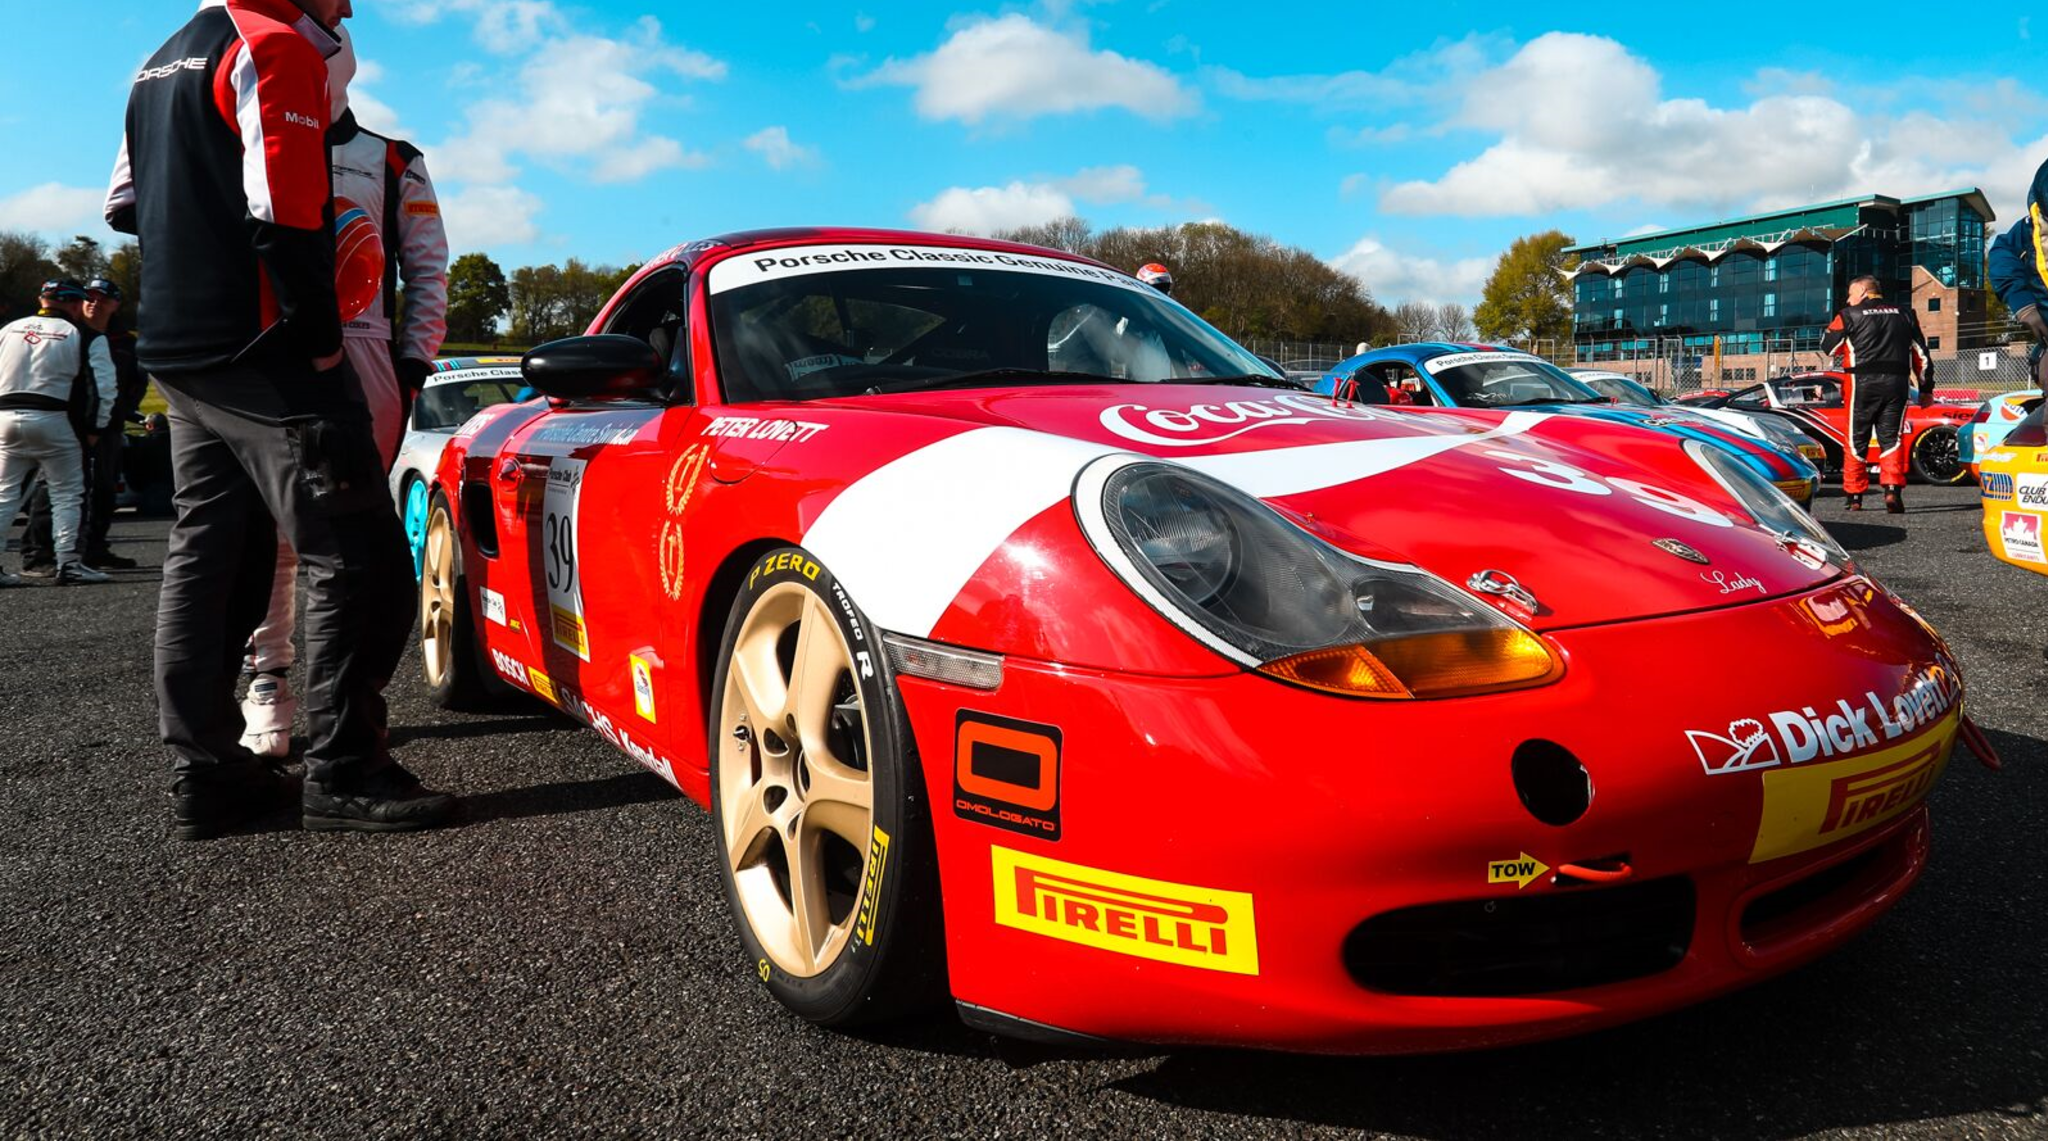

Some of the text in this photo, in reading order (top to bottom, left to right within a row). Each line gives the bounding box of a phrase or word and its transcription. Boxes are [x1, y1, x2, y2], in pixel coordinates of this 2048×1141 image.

[135, 58, 208, 83] ORSCHE
[285, 111, 319, 129] Mobil
[754, 249, 886, 272] Porsche
[888, 249, 991, 266] Classic
[993, 255, 1100, 279] Genuine
[433, 370, 488, 383] Porsche
[700, 416, 830, 443] PETER LOVETT
[1484, 450, 1734, 528] 39
[2019, 485, 2046, 496] CLUB
[2022, 495, 2048, 506] ENDU
[546, 512, 574, 594] 39
[749, 552, 820, 590] P ZERO
[1700, 570, 1767, 595] Lady
[554, 610, 587, 647] PIRELLI
[832, 582, 874, 680] TROFEO R
[491, 647, 531, 687] BOSCH
[561, 687, 621, 747] SACHS
[1768, 668, 1949, 763] Dick Lovett
[1817, 740, 1942, 835] PIRELLI
[955, 799, 1056, 832] OMOLOGATO
[856, 825, 890, 946] PIRELLI
[1491, 862, 1536, 879] TOW
[1013, 865, 1229, 957] PIRELLI
